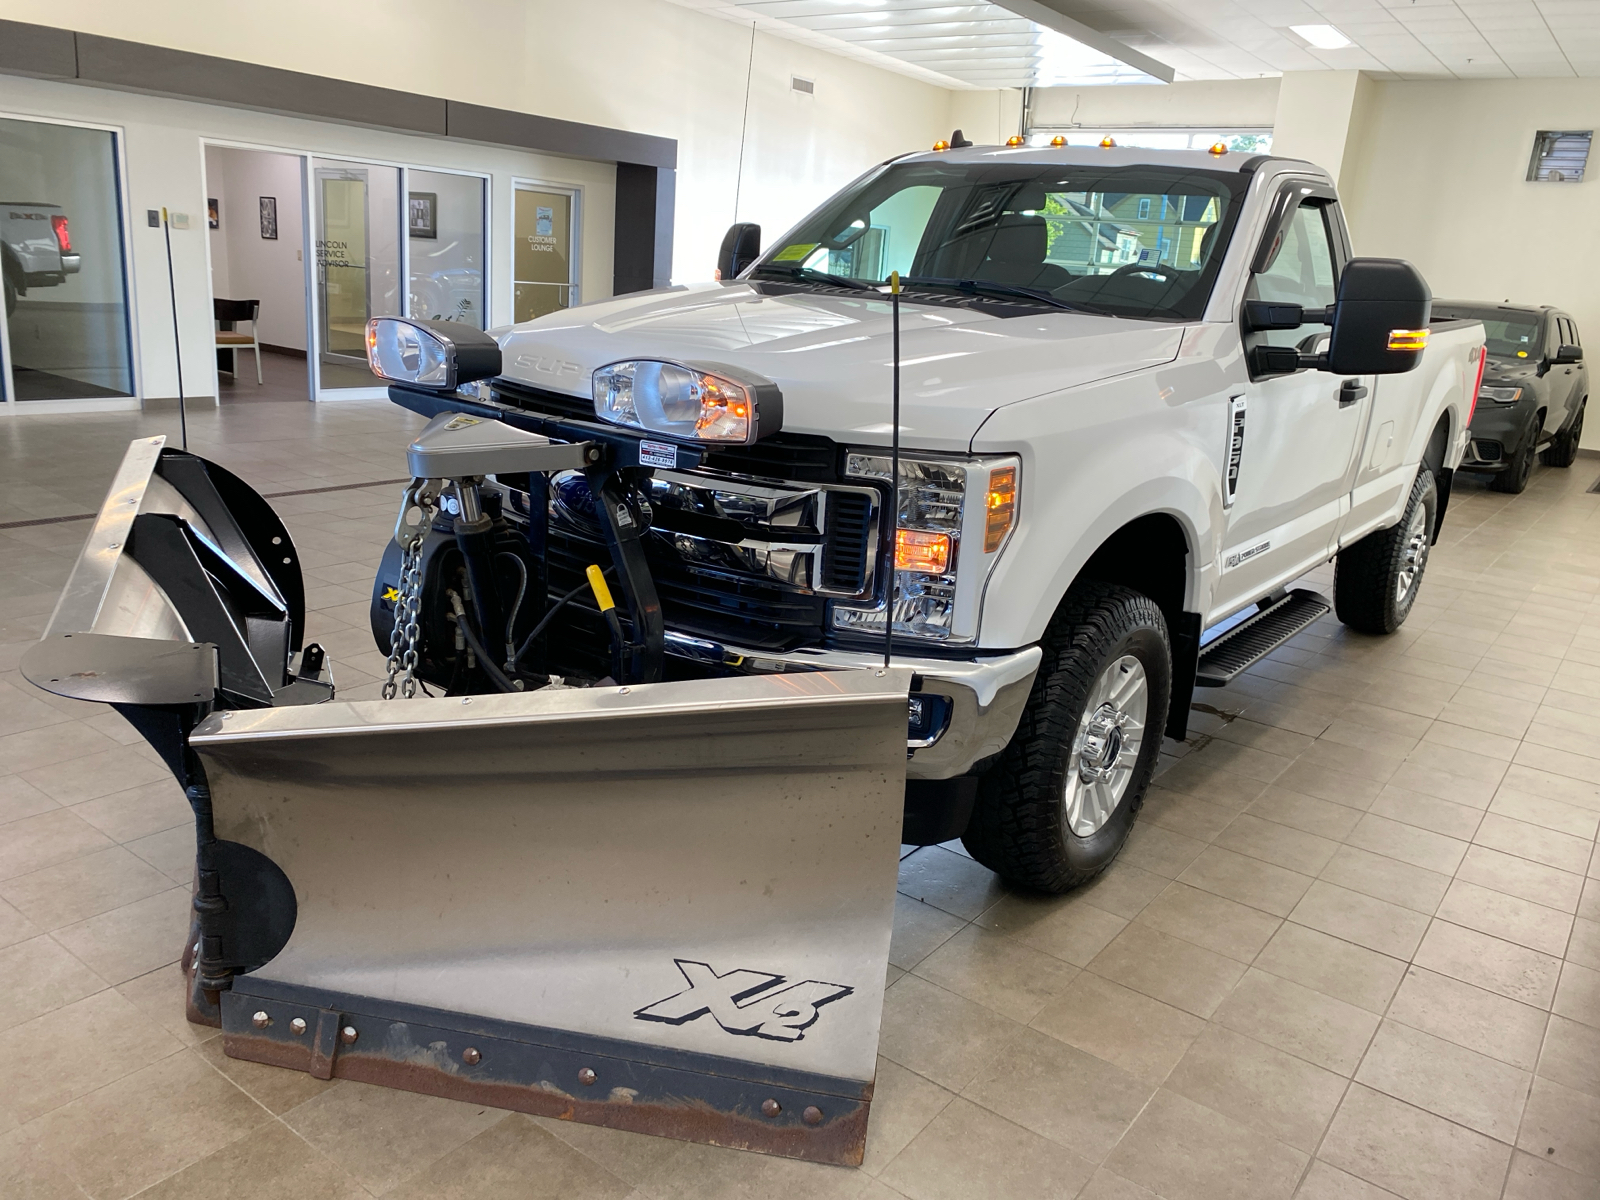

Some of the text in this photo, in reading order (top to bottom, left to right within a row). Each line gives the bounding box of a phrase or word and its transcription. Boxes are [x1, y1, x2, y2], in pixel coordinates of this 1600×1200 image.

[315, 240, 348, 249] LINCOLN
[528, 236, 557, 244] CUSTOMER
[531, 244, 554, 252] LOUNGE
[316, 249, 346, 258] SERVICE
[317, 259, 350, 268] ADVISOR
